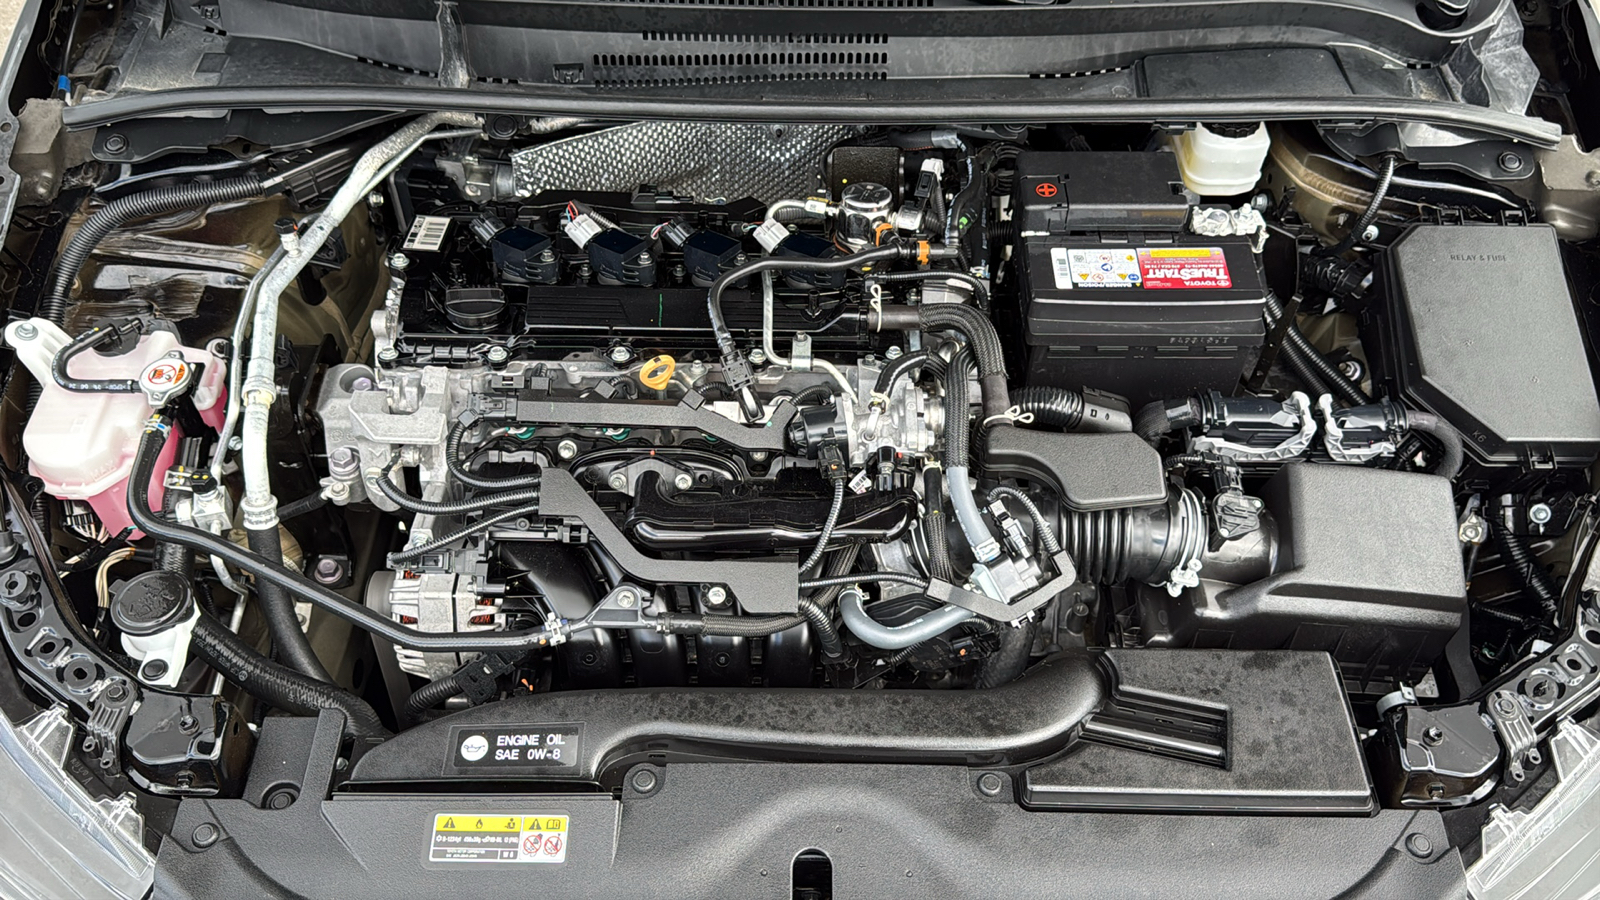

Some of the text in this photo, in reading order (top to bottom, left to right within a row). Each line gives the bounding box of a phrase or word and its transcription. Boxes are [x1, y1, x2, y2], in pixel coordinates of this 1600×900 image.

[496, 733, 566, 746] ENGINE OIL
[495, 748, 561, 760] SAE 0W-8
